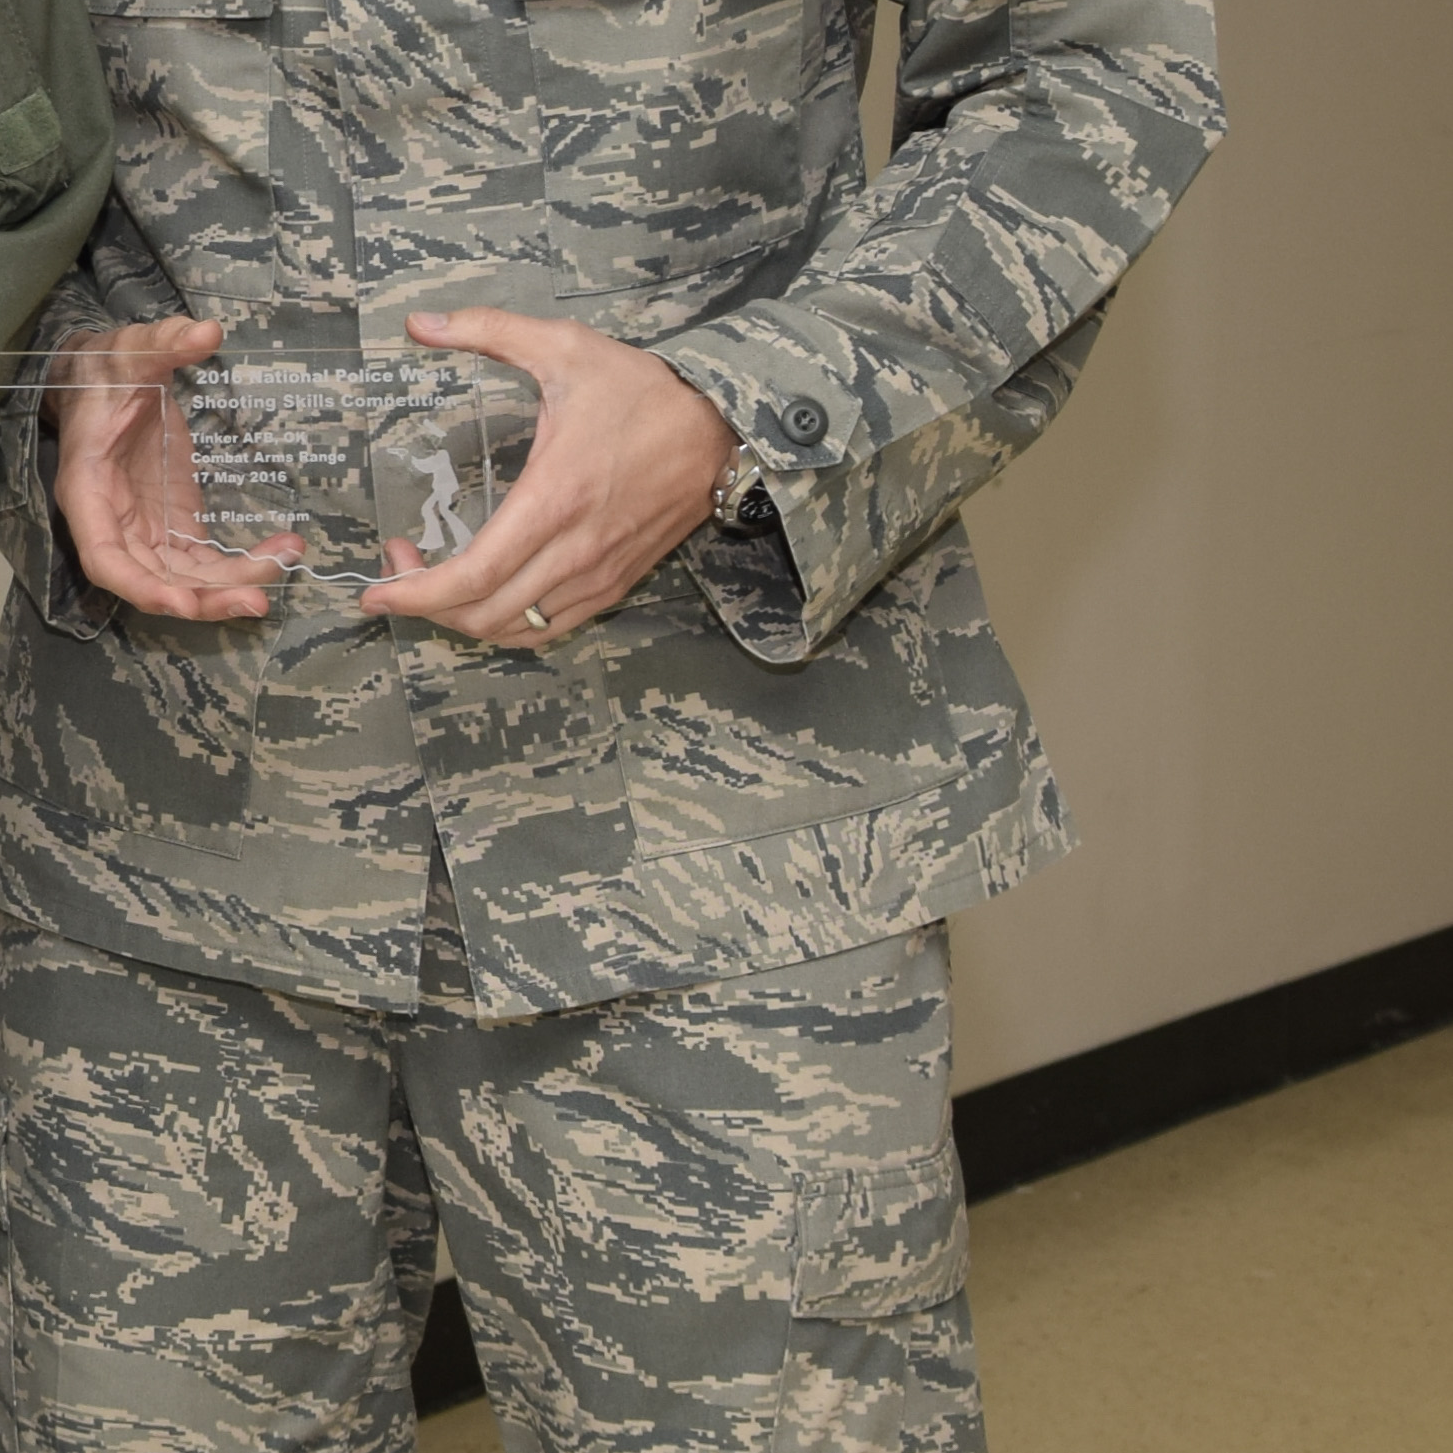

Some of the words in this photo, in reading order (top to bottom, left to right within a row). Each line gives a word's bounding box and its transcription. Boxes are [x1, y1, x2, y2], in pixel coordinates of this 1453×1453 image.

[197, 370, 242, 385] 2016
[335, 369, 393, 382] Police
[399, 368, 452, 382] Week
[192, 395, 276, 412] Shooting
[283, 394, 335, 409] Skills
[190, 432, 238, 444] Tinker
[190, 451, 249, 464] Combat
[253, 451, 293, 463] Arms
[298, 450, 346, 465] Range
[192, 472, 209, 483] 17
[214, 471, 245, 486] May
[249, 471, 287, 483] 2016
[192, 512, 216, 523] 1st
[220, 511, 262, 523] Place
